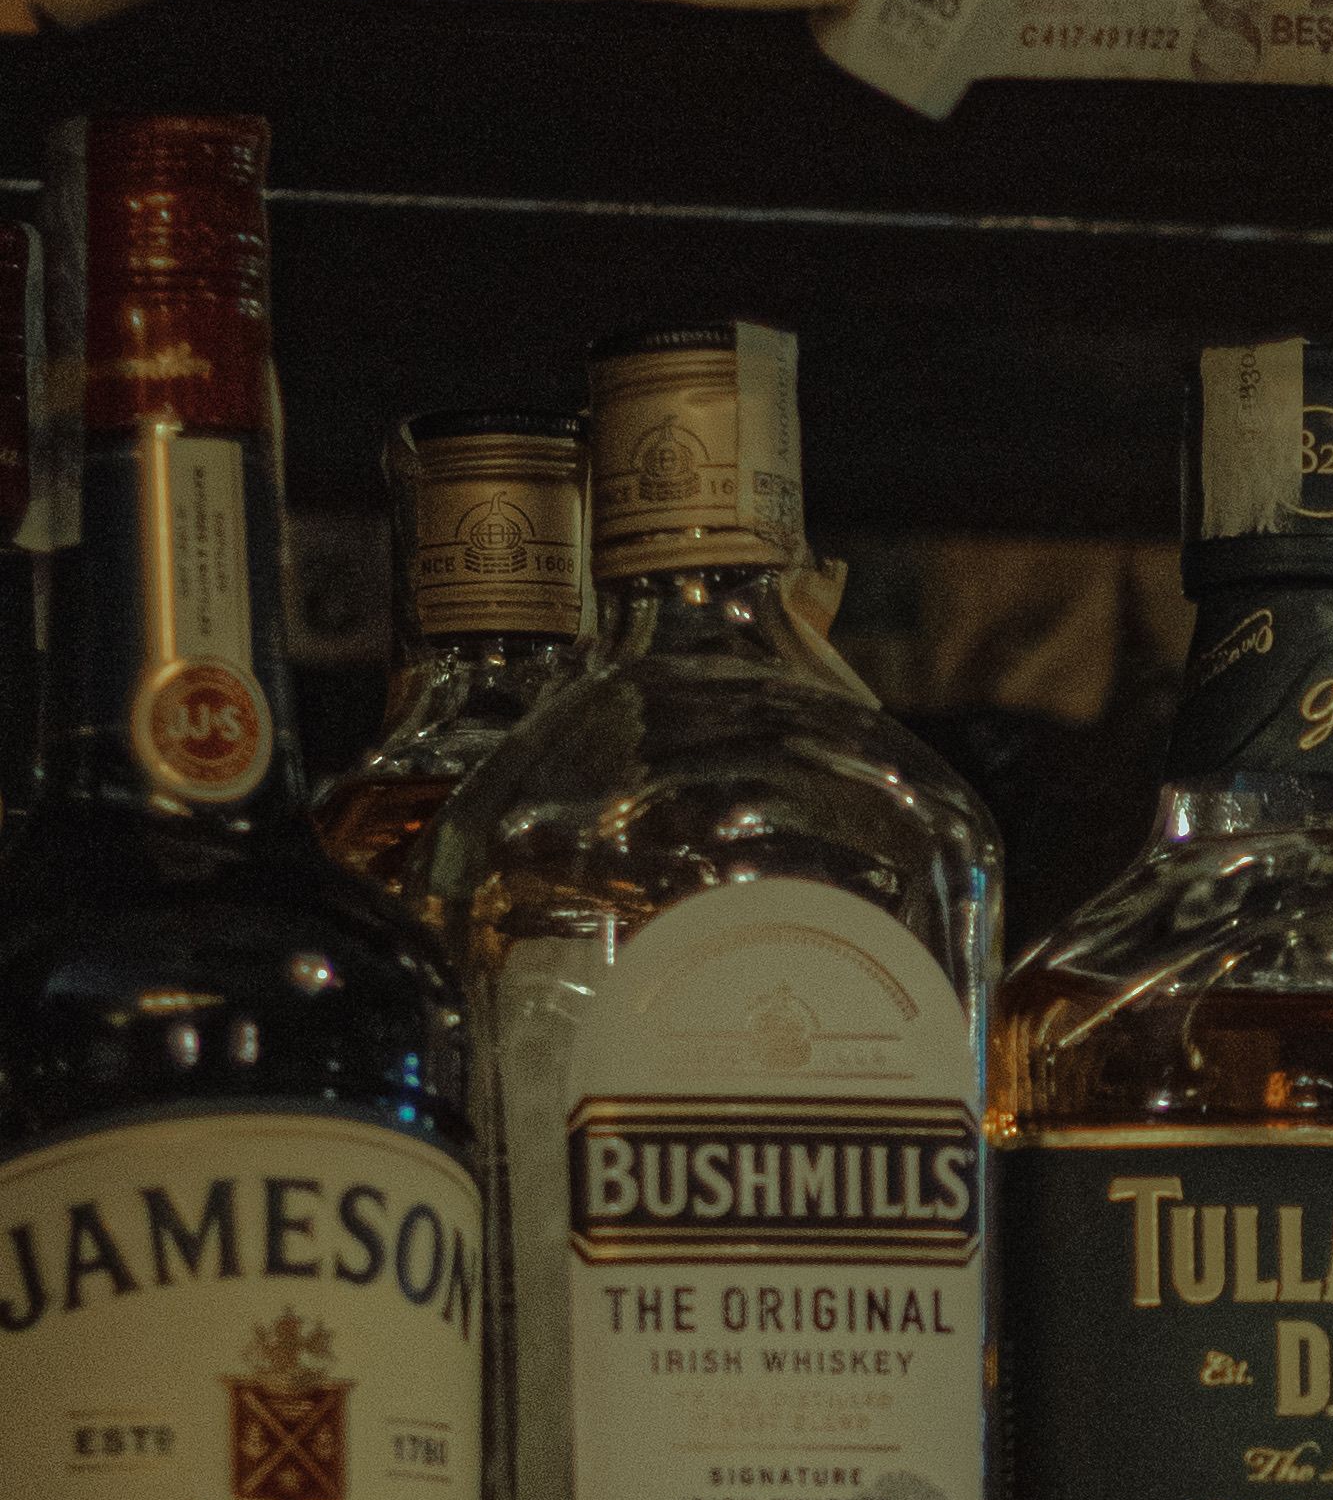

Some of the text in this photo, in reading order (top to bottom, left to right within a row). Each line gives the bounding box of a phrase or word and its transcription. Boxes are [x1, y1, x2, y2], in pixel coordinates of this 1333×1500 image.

[584, 1136, 971, 1222] BUSHMILLS
[0, 1175, 479, 1343] JAMESON
[603, 1284, 957, 1336] THE ORIGINAL
[649, 1348, 916, 1377] IRISH WHISKEY
[1199, 1350, 1255, 1388] Est.
[707, 1466, 866, 1488] SIGNATURE
[1242, 1439, 1322, 1485] The
